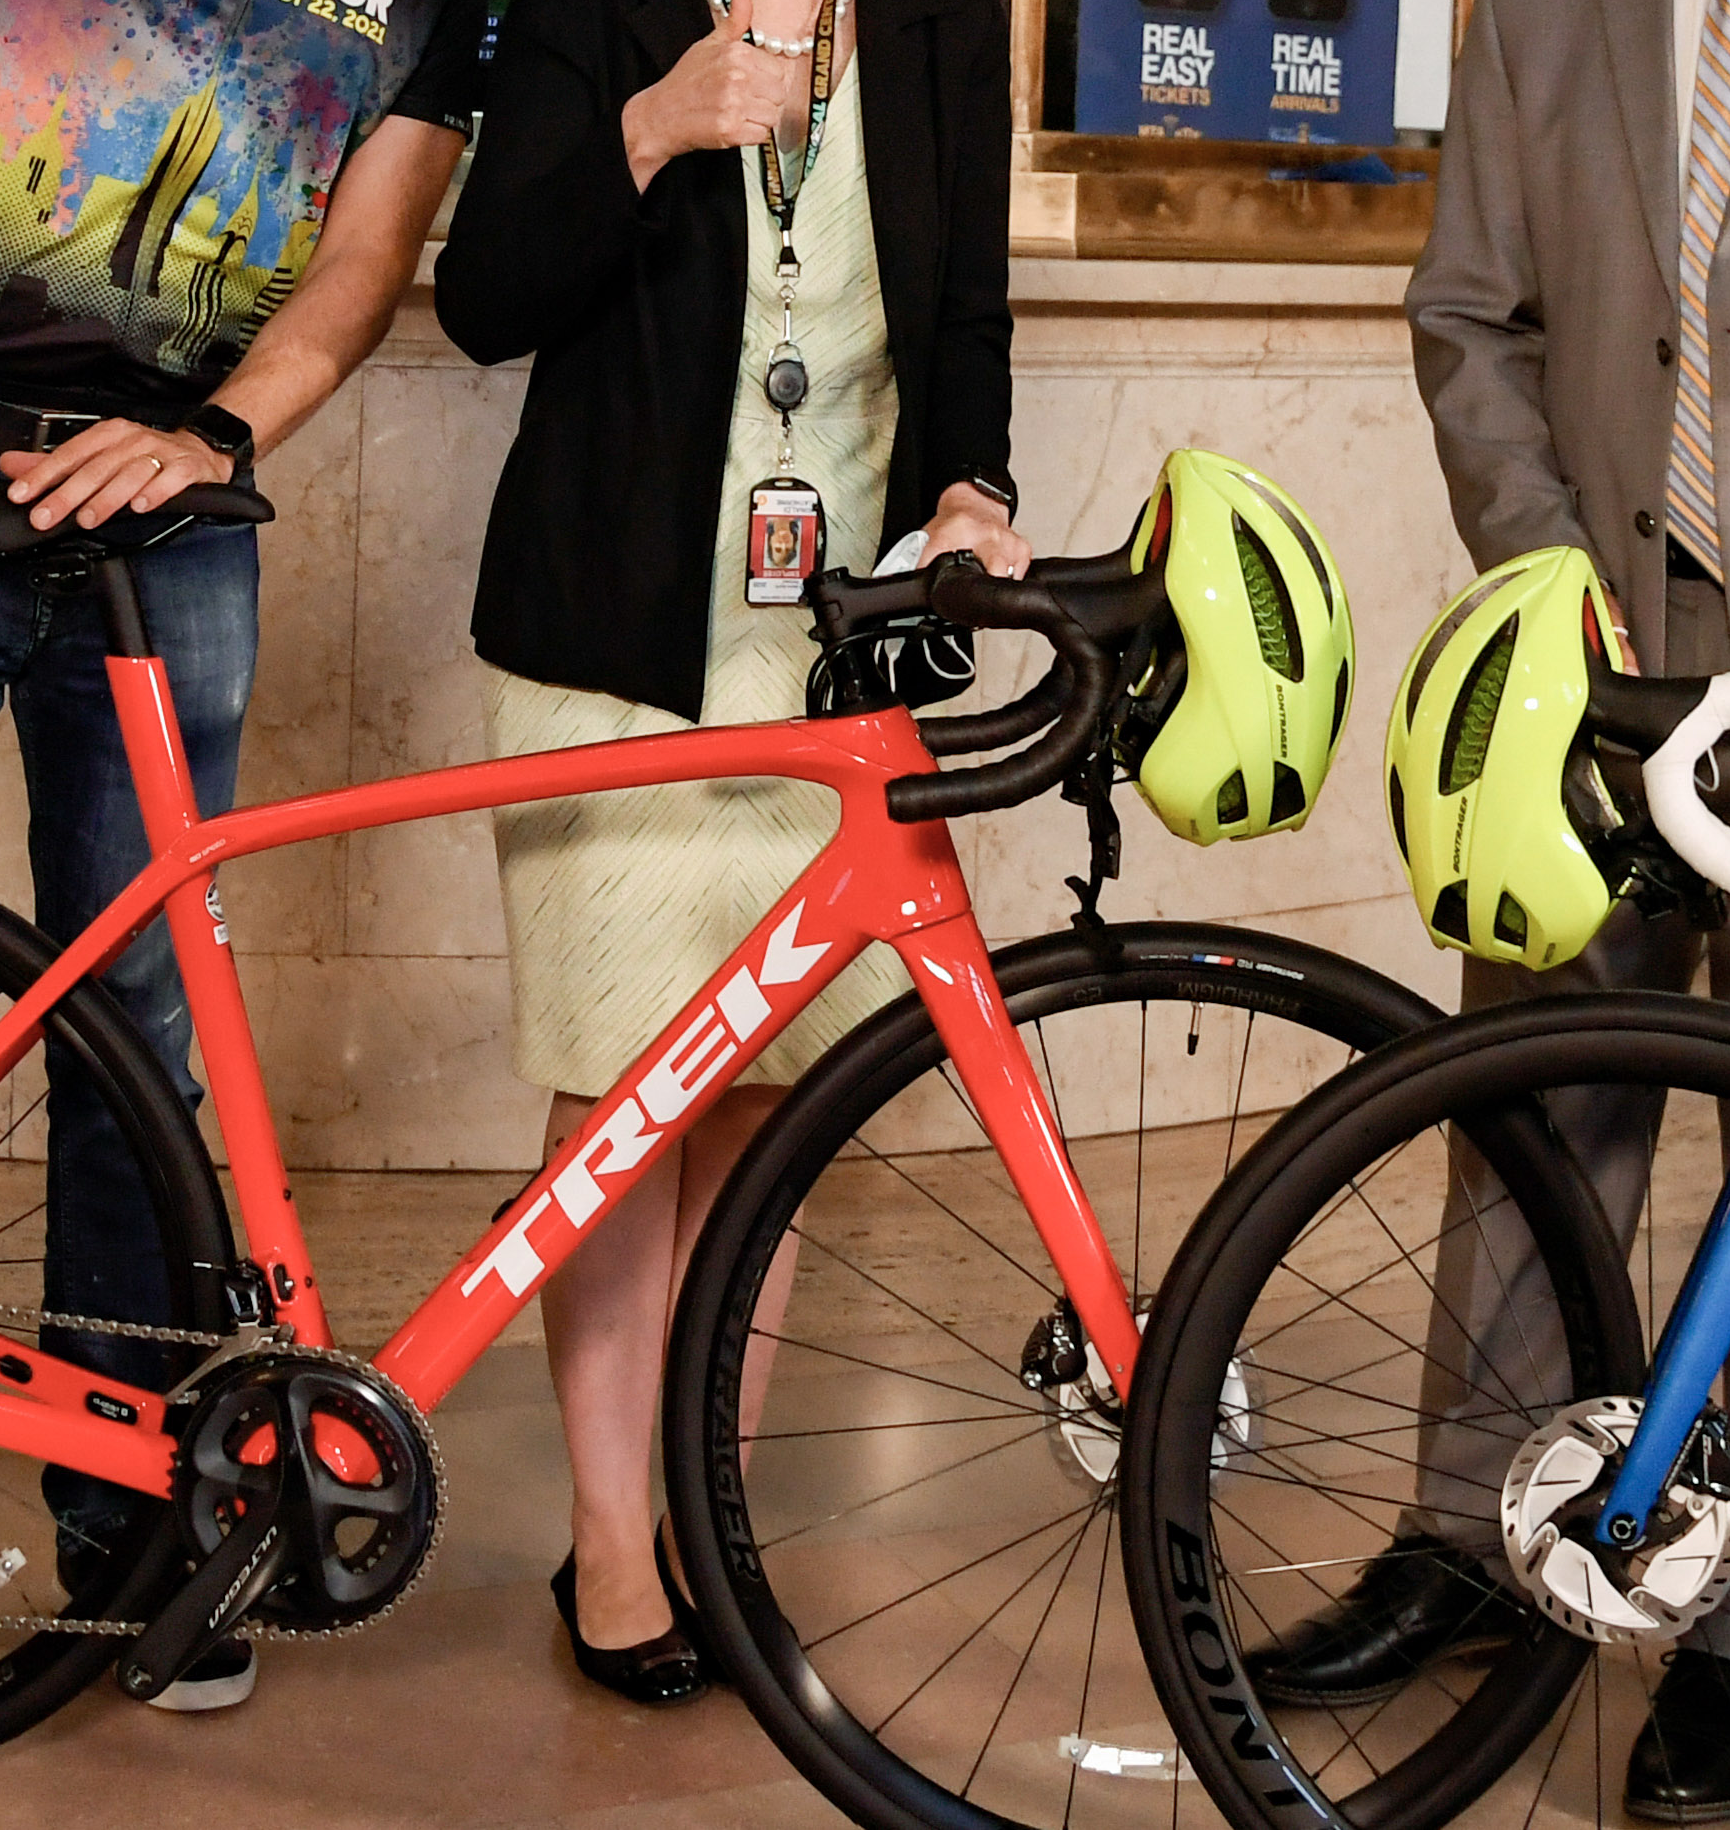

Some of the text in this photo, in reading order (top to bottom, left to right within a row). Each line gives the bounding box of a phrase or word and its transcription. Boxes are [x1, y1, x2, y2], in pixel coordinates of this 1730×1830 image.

[341, 8, 388, 46] 2021
[1142, 23, 1215, 58] REAL
[1273, 33, 1341, 68] REAL
[813, 38, 831, 100] GRAND
[1141, 54, 1216, 88] EASY
[1271, 63, 1342, 97] TIME
[1140, 84, 1212, 108] TICKETS
[1270, 94, 1341, 115] ARRIVALS
[1275, 684, 1288, 759] BONTRAGER
[1452, 796, 1468, 874] BONTRAGER
[460, 896, 834, 1299] TREK
[209, 1525, 278, 1630] ULTEGRA
